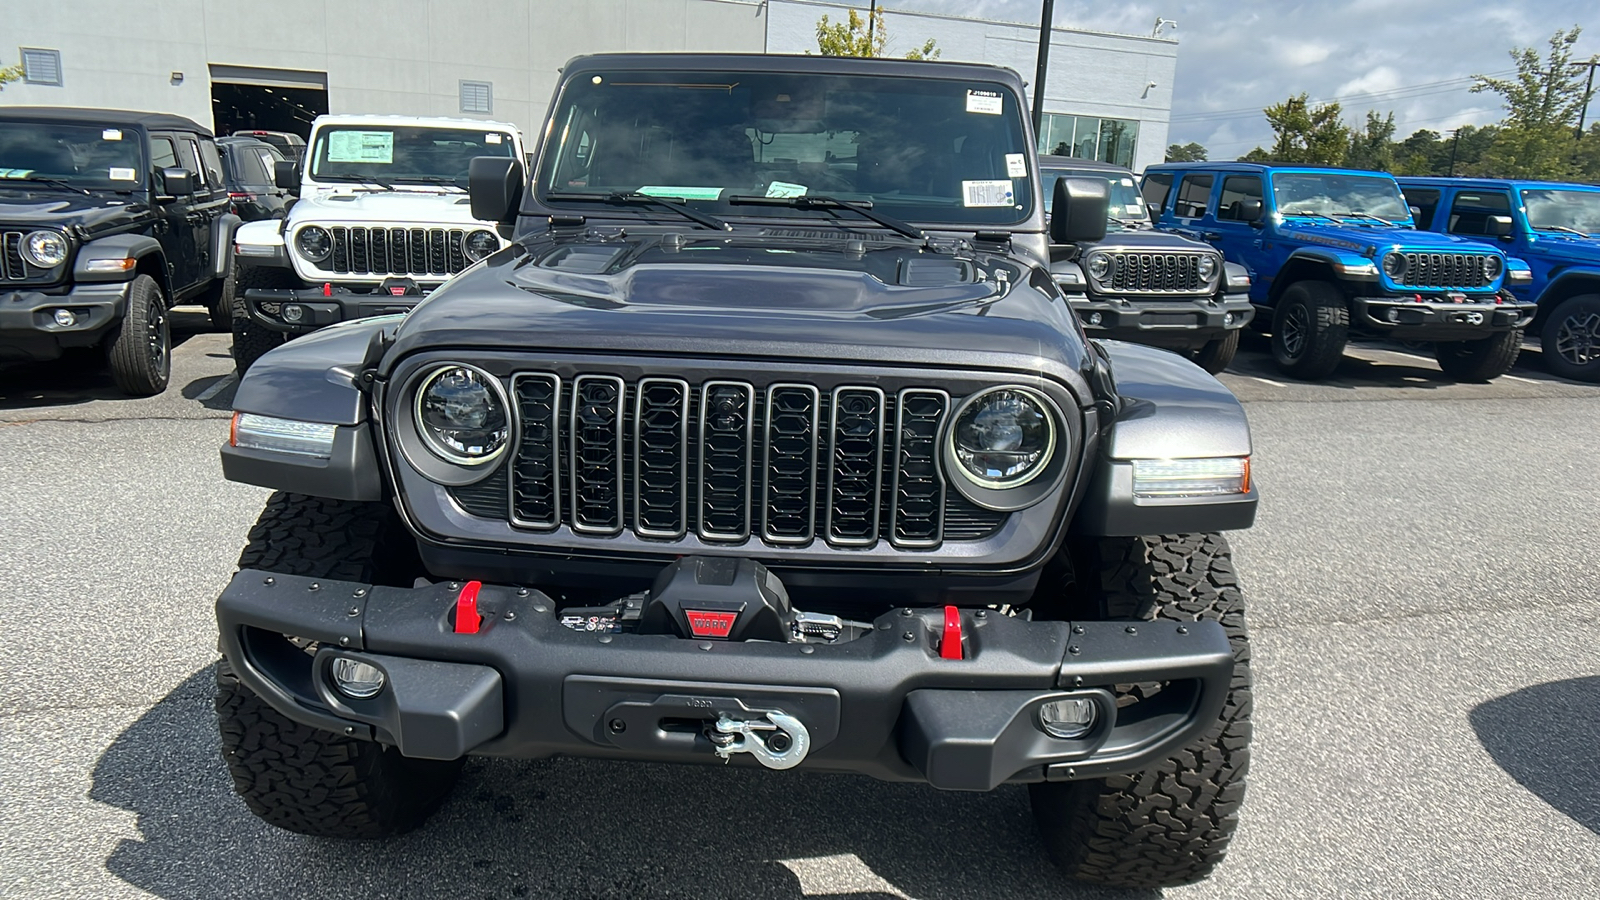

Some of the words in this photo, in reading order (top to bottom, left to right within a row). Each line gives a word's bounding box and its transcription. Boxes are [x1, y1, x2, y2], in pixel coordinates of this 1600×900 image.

[1294, 232, 1362, 250] RUBICON
[694, 618, 728, 629] WARN
[686, 697, 713, 708] Jeep
